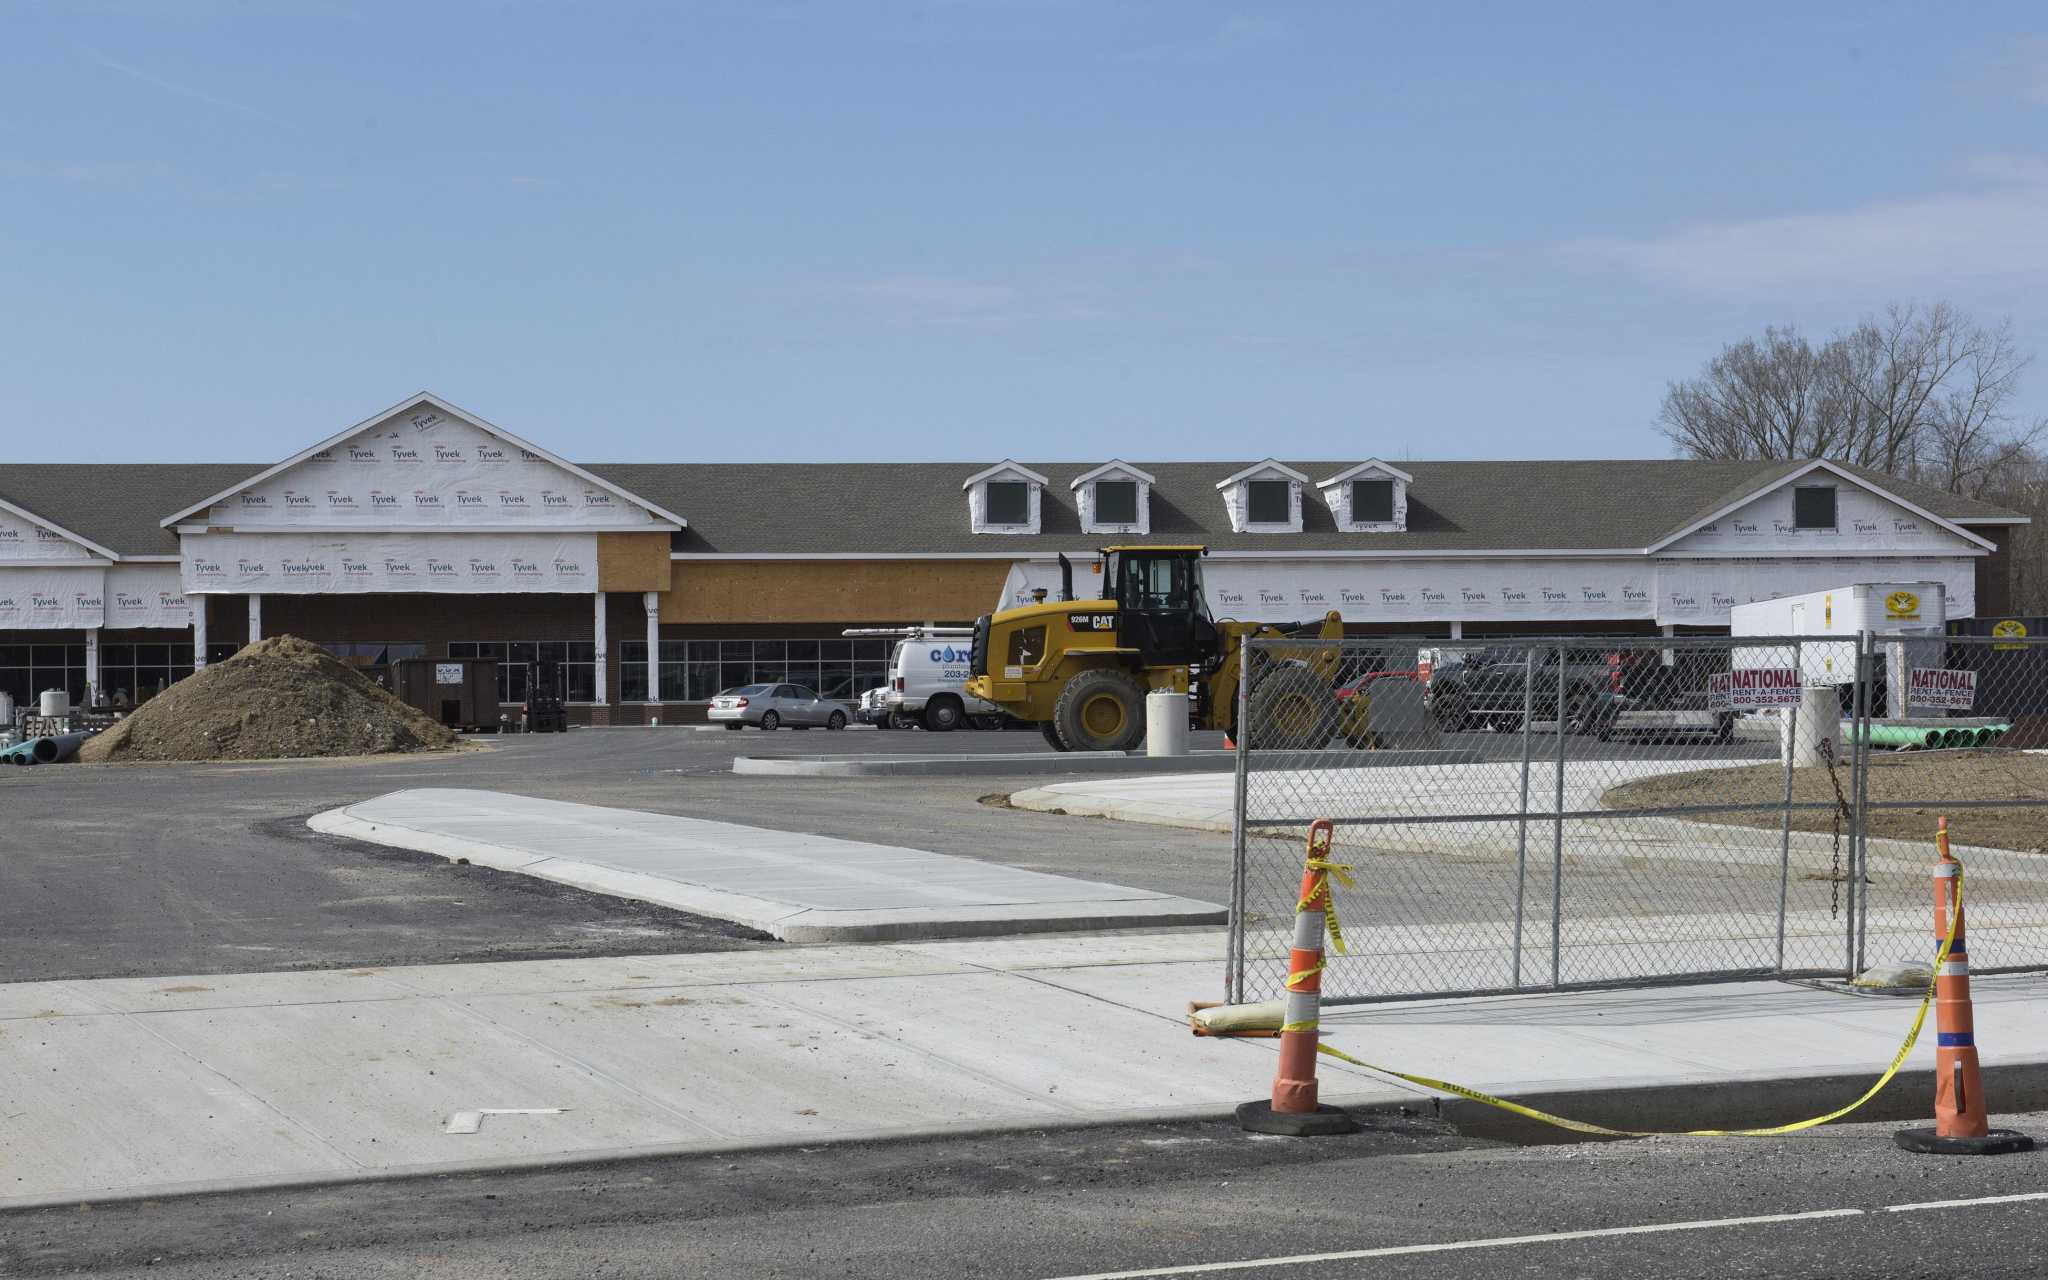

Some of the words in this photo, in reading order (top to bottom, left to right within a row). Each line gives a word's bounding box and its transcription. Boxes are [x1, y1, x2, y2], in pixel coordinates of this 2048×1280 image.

[1092, 615, 1114, 629] CAT
[1732, 669, 1801, 689] NATIONAL
[1911, 670, 1974, 690] NATIONAL
[1733, 688, 1801, 696] RENT-A-FENCE
